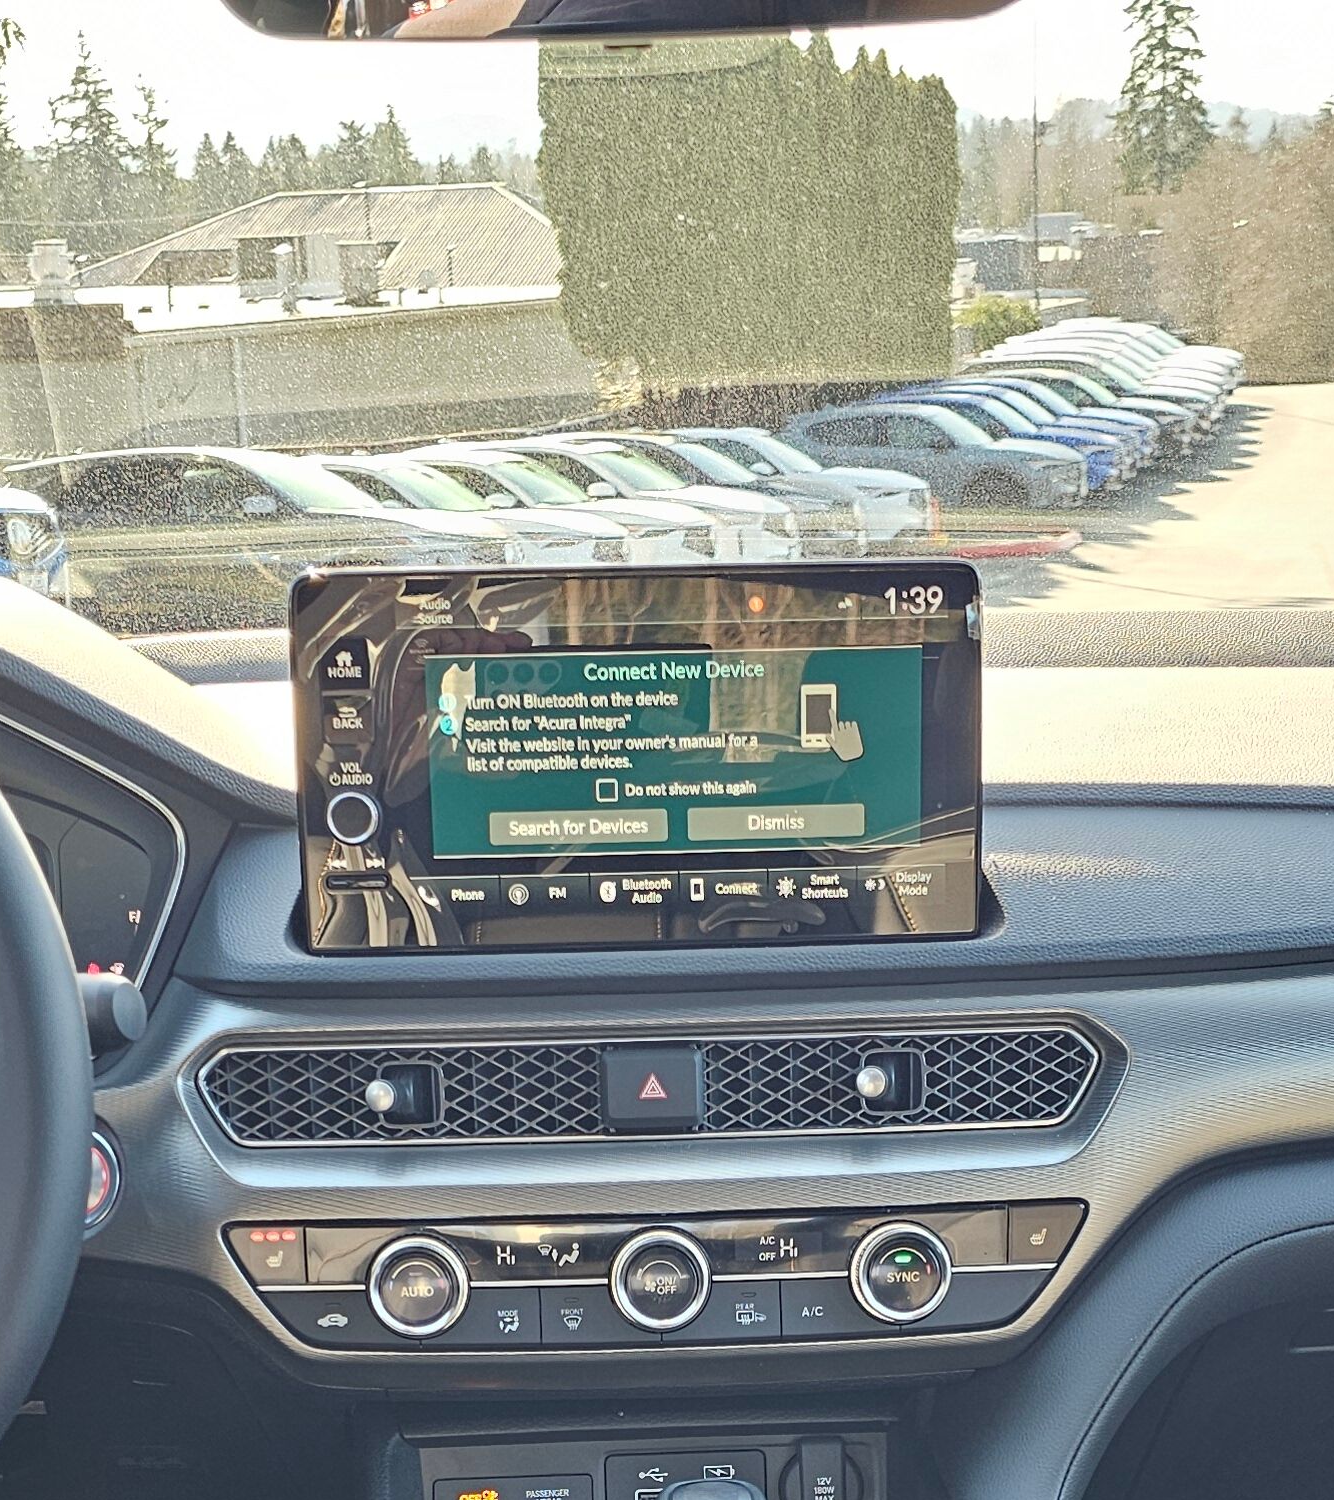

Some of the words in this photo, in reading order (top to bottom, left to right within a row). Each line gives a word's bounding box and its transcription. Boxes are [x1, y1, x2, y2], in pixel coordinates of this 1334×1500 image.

[419, 598, 451, 611] Audio
[884, 584, 944, 616] 1:39
[417, 613, 454, 625] Source
[327, 666, 362, 679] HOME
[583, 662, 657, 682] Connect
[661, 661, 702, 680] New
[705, 660, 765, 679] Device
[464, 693, 495, 710] Turn
[496, 694, 522, 710] ON
[523, 692, 589, 709] Bluetooth
[590, 695, 609, 708] on
[611, 692, 634, 708] the
[635, 691, 679, 707] device
[332, 717, 364, 730] BACK
[465, 716, 509, 733] Search
[511, 716, 533, 731] for
[533, 714, 577, 731] "Acura
[579, 713, 632, 732] Integra"
[465, 738, 496, 754] Visit
[498, 737, 522, 753] the
[523, 736, 575, 752] website
[577, 736, 590, 751] in
[592, 738, 624, 754] your
[624, 734, 676, 751] owner's
[678, 733, 726, 749] manual
[728, 732, 749, 748] for
[748, 735, 759, 747] a
[339, 761, 362, 774] VOL
[466, 756, 488, 773] list
[489, 756, 505, 771] of
[506, 754, 579, 773] compatible
[580, 753, 633, 770] devices.
[342, 773, 373, 786] AUDIO
[625, 782, 641, 797] Do
[645, 783, 668, 797] not
[668, 781, 701, 796] show
[702, 780, 725, 795] this
[726, 780, 757, 797] again
[509, 818, 560, 838] Search
[563, 818, 585, 836] for
[589, 817, 649, 836] Devices
[747, 813, 805, 832] Dismiss
[622, 877, 672, 891] Bluetooth
[810, 873, 840, 887] Smart
[895, 871, 932, 886] Display
[450, 888, 486, 902] Phone
[548, 886, 567, 899] FM
[715, 882, 758, 896] Connect
[801, 886, 849, 900] Shortcuts
[899, 884, 928, 897] Mode
[631, 891, 663, 905] Audio
[759, 1236, 776, 1246] A/C
[759, 1252, 776, 1262] OFF
[656, 1276, 677, 1286] ON/
[886, 1271, 921, 1284] SYNC
[401, 1286, 434, 1298] AUTO
[656, 1285, 677, 1295] OFF
[561, 1308, 583, 1316] FRONT
[801, 1306, 824, 1318] A/C
[817, 1477, 832, 1486] 12V
[526, 1489, 569, 1498] PASSENGER
[814, 1486, 835, 1495] 180W
